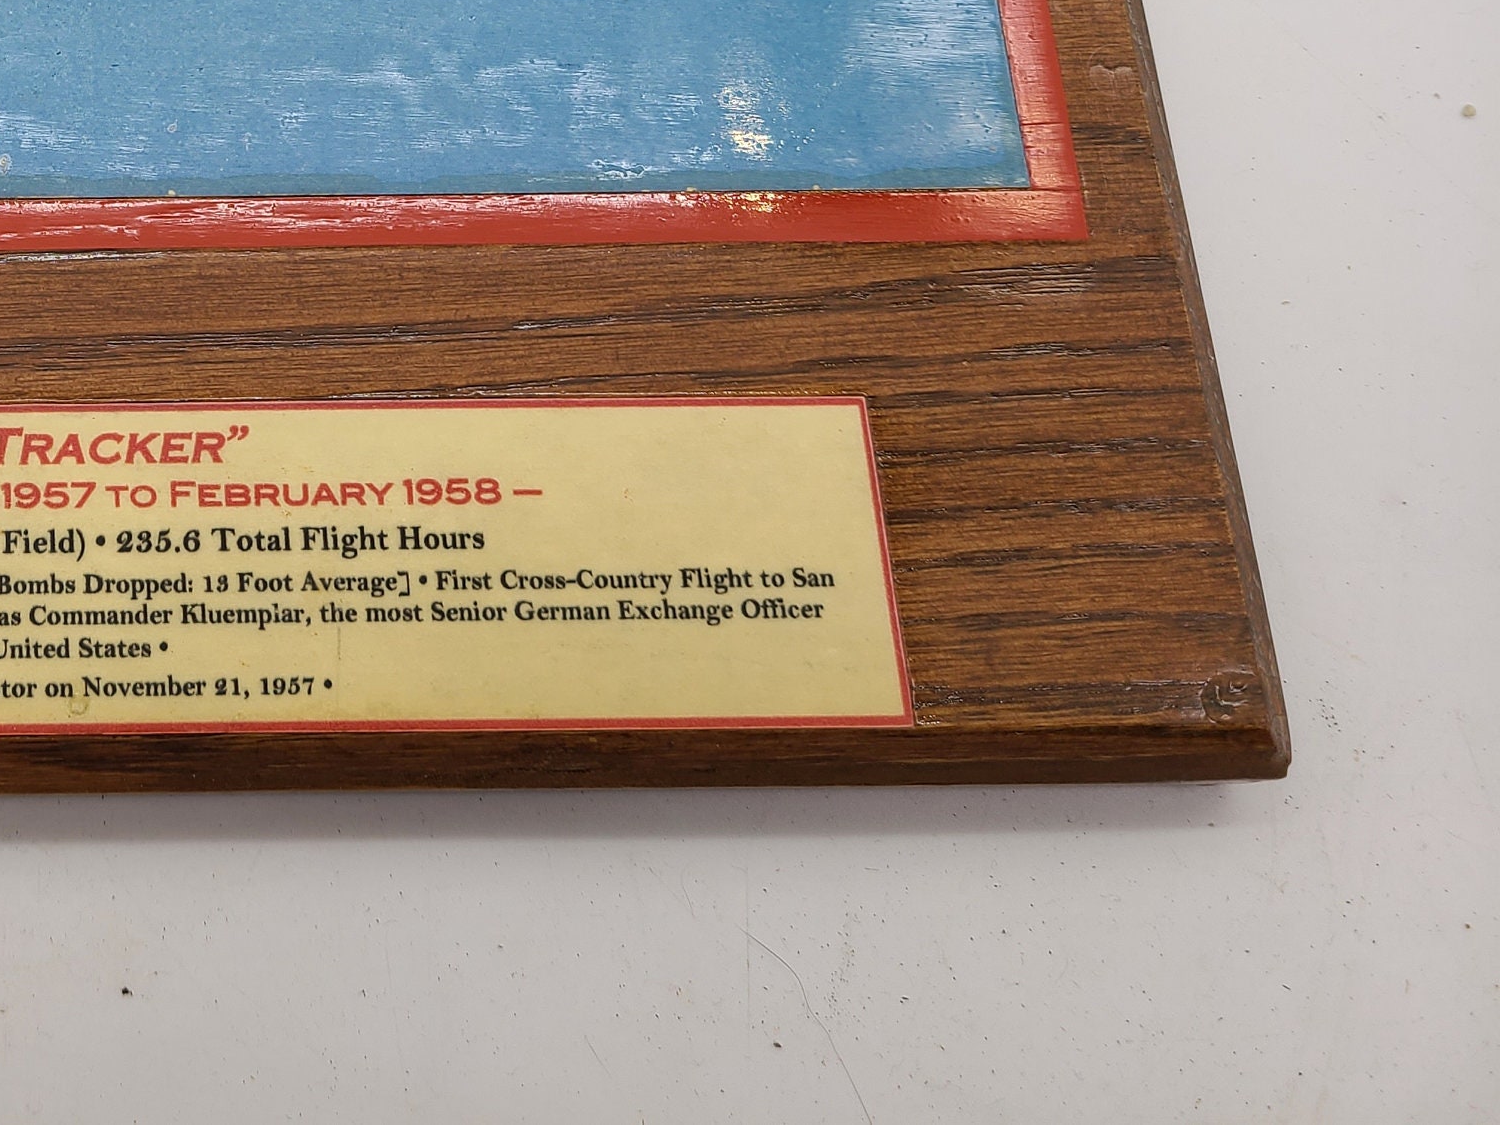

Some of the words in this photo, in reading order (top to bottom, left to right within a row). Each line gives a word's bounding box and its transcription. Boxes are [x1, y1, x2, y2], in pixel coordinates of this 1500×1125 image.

[0, 480, 97, 511] 1957
[108, 484, 158, 509] TO
[169, 479, 394, 508] FEBRUARY
[402, 477, 503, 507] 1958
[2, 528, 86, 562] Field)
[116, 528, 201, 554] 235.6
[210, 526, 292, 552] Total
[299, 525, 390, 558] Flight
[396, 526, 485, 550] Hours
[82, 572, 193, 601] Dropped:
[236, 571, 294, 593] Foot
[300, 570, 411, 598] Average]
[435, 569, 493, 591] First
[500, 569, 672, 596] Cross-Country
[679, 567, 753, 595] Flight
[759, 570, 785, 588] to
[792, 567, 835, 588] San
[29, 603, 173, 626] Commander
[319, 601, 358, 623] the
[365, 604, 424, 623] most
[430, 600, 508, 622] Senior
[514, 600, 611, 621] German
[617, 598, 734, 625] Exchange
[740, 597, 824, 619] Officer
[78, 637, 152, 659] States
[44, 682, 74, 698] on
[81, 674, 207, 697] November
[214, 677, 250, 700] 21,
[260, 676, 315, 696] 1957
